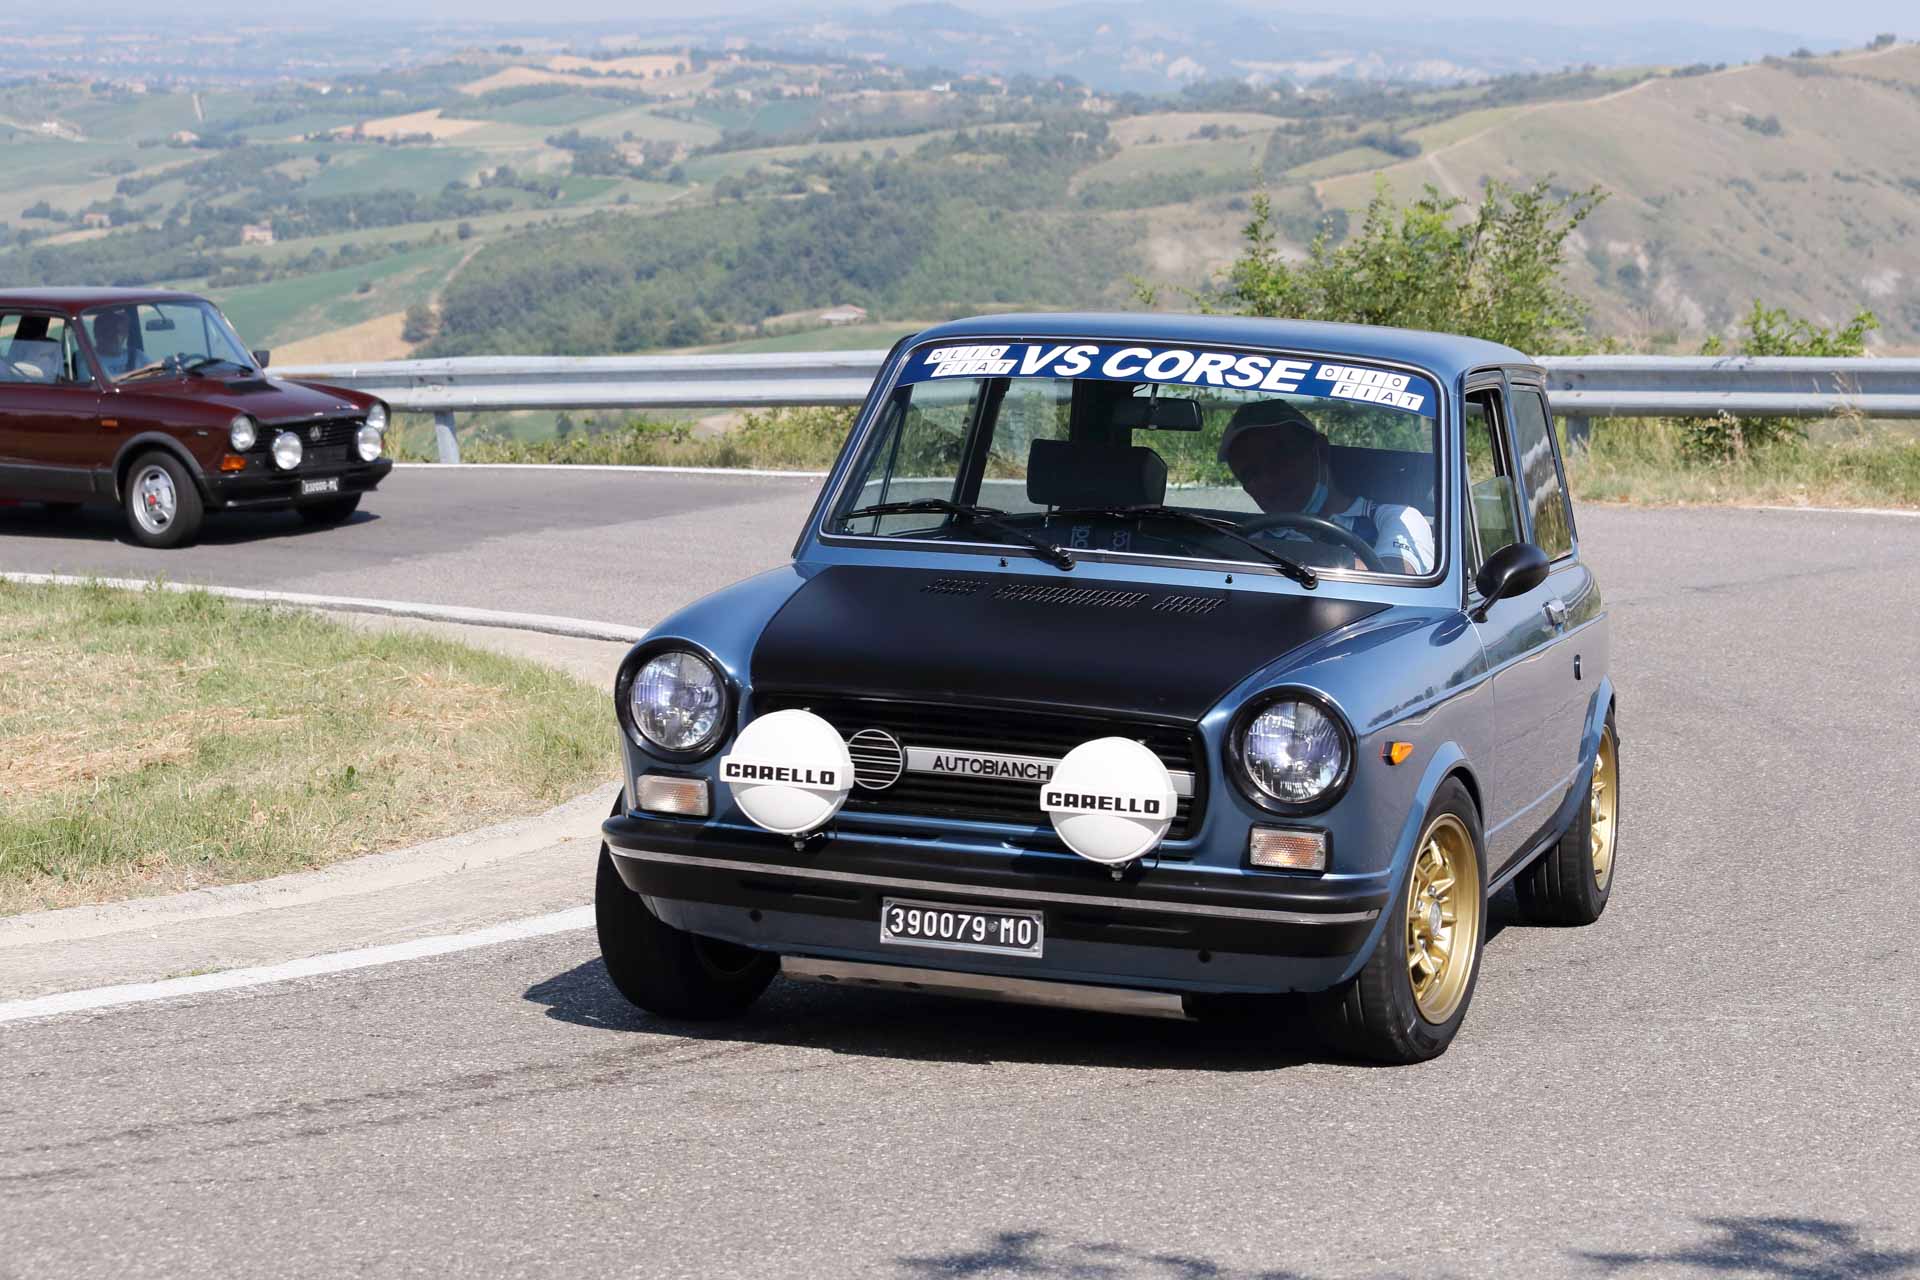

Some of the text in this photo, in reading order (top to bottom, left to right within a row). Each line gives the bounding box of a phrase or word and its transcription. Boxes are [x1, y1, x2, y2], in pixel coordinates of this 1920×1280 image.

[932, 348, 1001, 361] OLIO
[938, 361, 1012, 374] FIAT
[1019, 345, 1312, 391] VS CORSE
[1324, 368, 1402, 387] OLIO
[1338, 384, 1418, 406] FIAT
[726, 763, 835, 785] CARELLO
[1046, 791, 1160, 815] CARELLO
[890, 908, 1032, 945] 390079 MO
